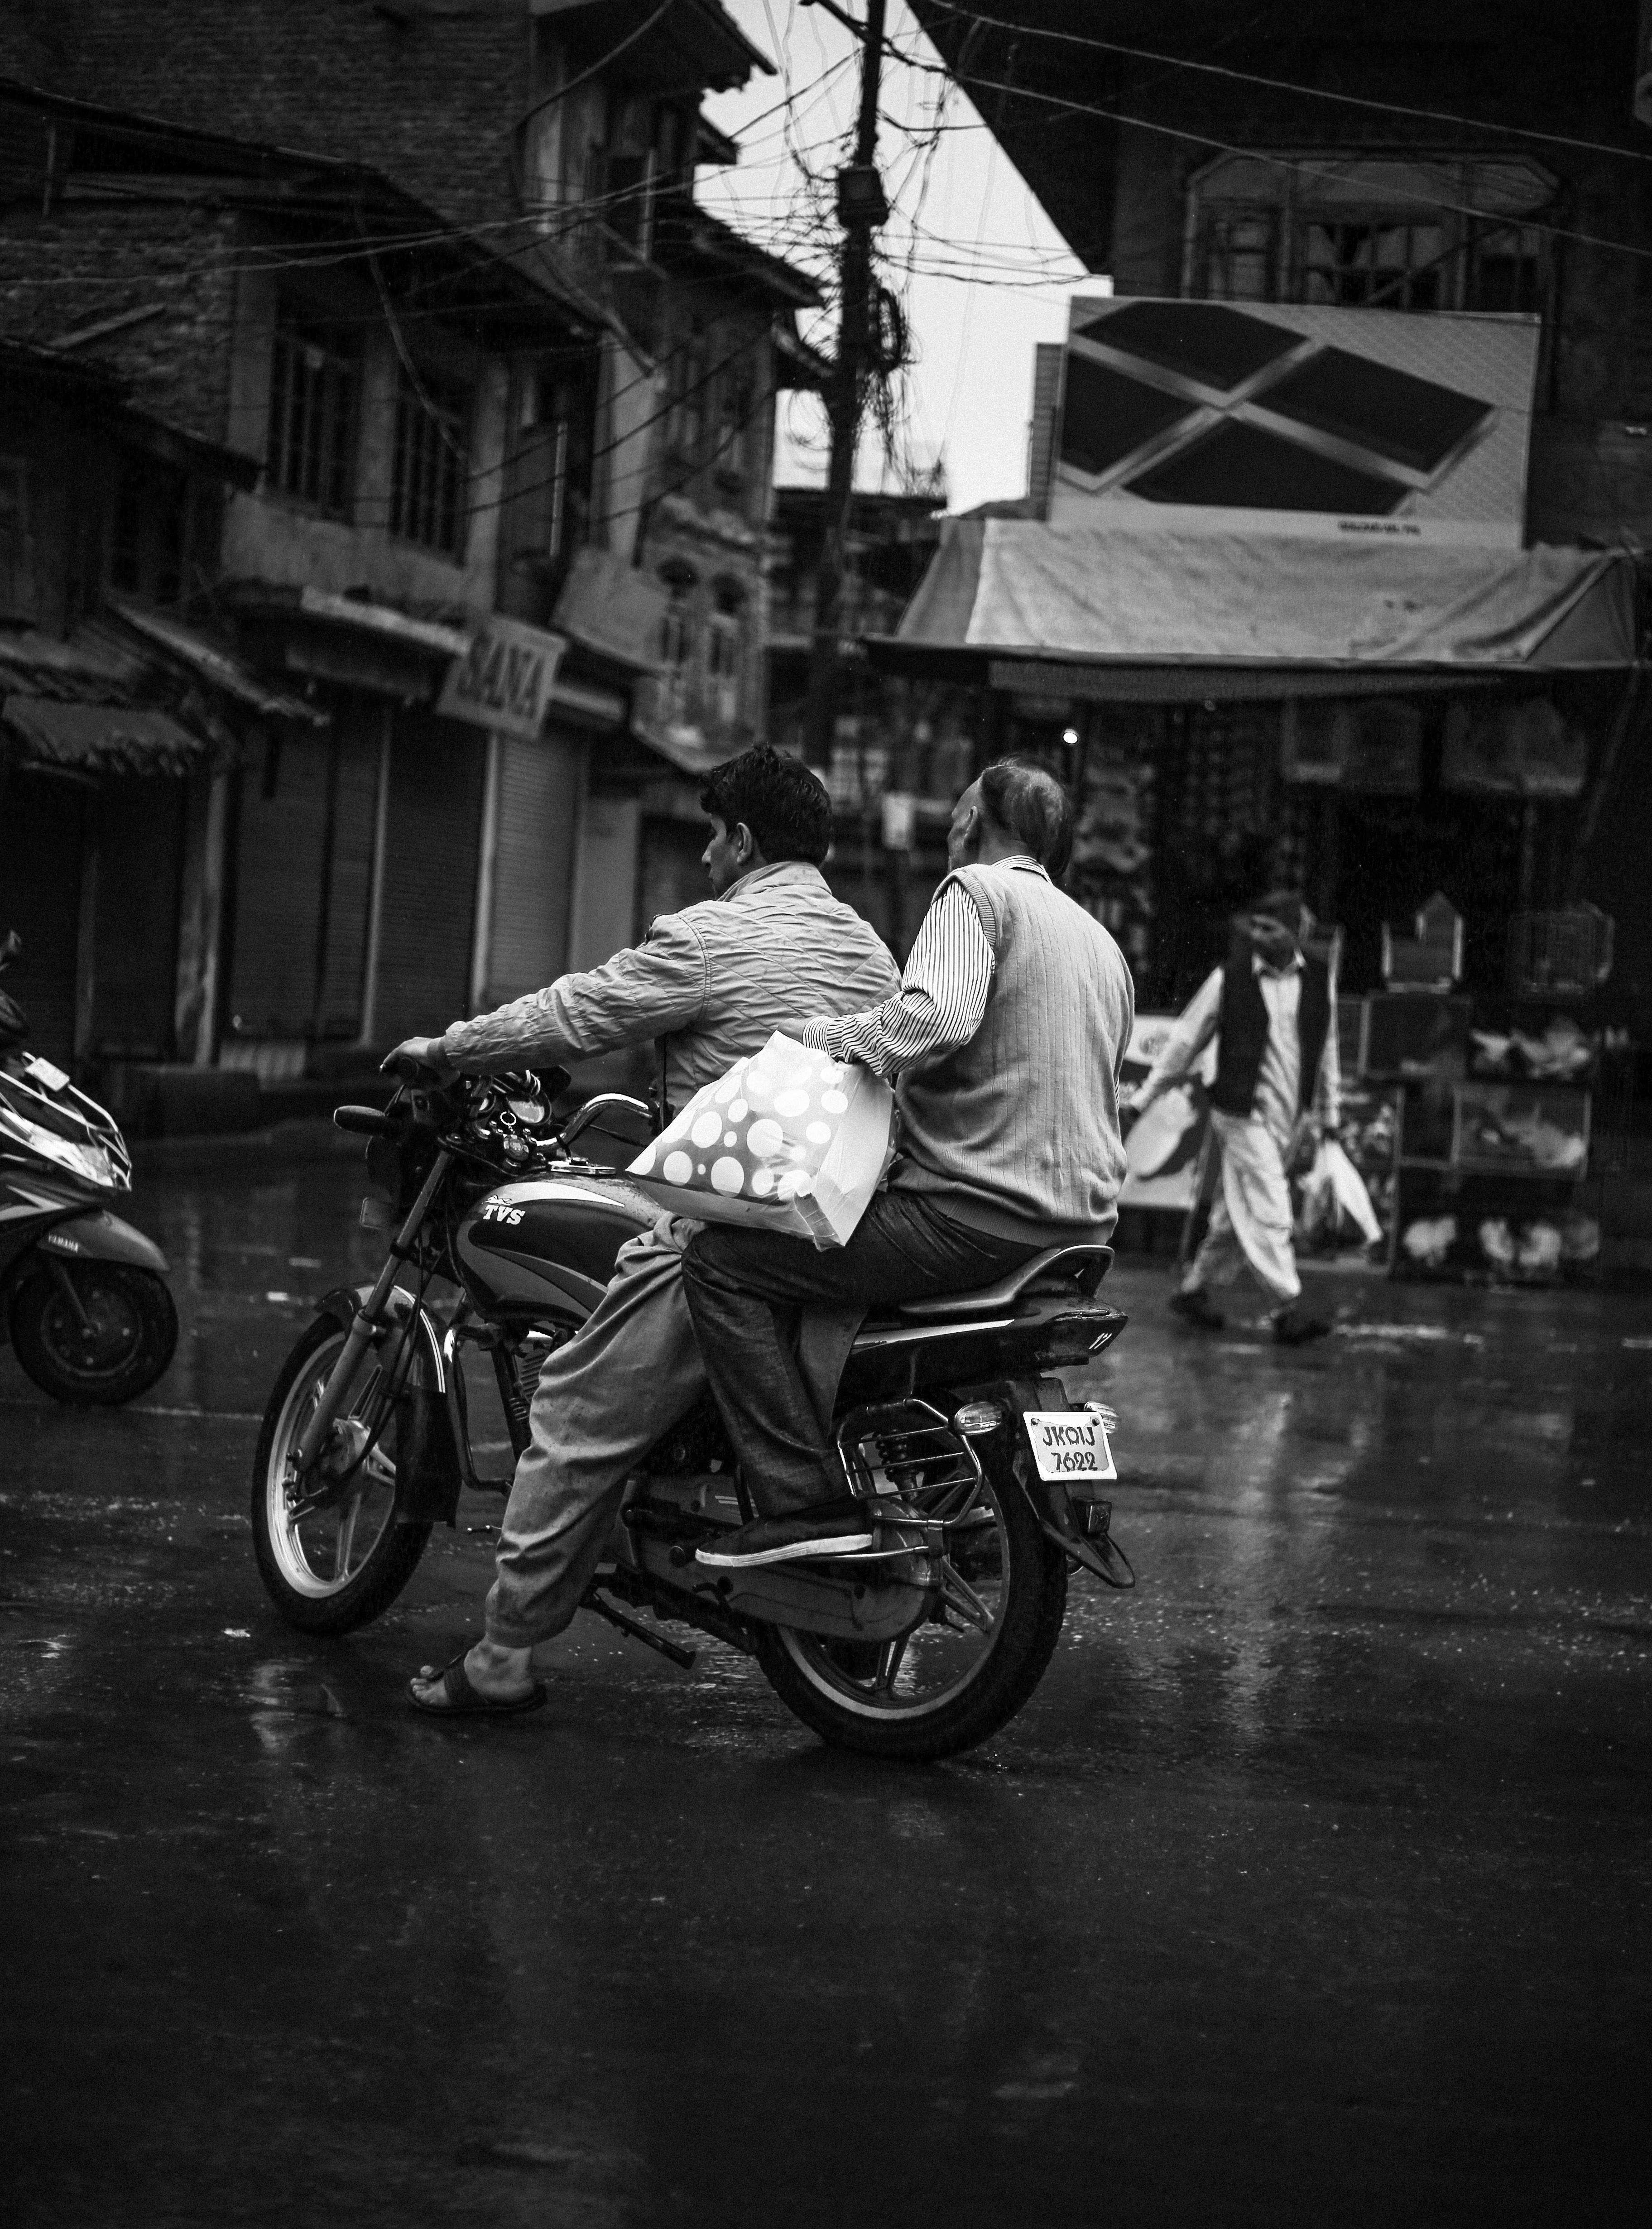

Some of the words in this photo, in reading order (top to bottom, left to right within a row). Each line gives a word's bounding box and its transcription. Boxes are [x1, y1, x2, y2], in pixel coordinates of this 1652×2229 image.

[483, 1205, 526, 1225] TVS
[48, 1233, 78, 1254] YAMAHA
[1051, 1452, 1098, 1472] 7622
